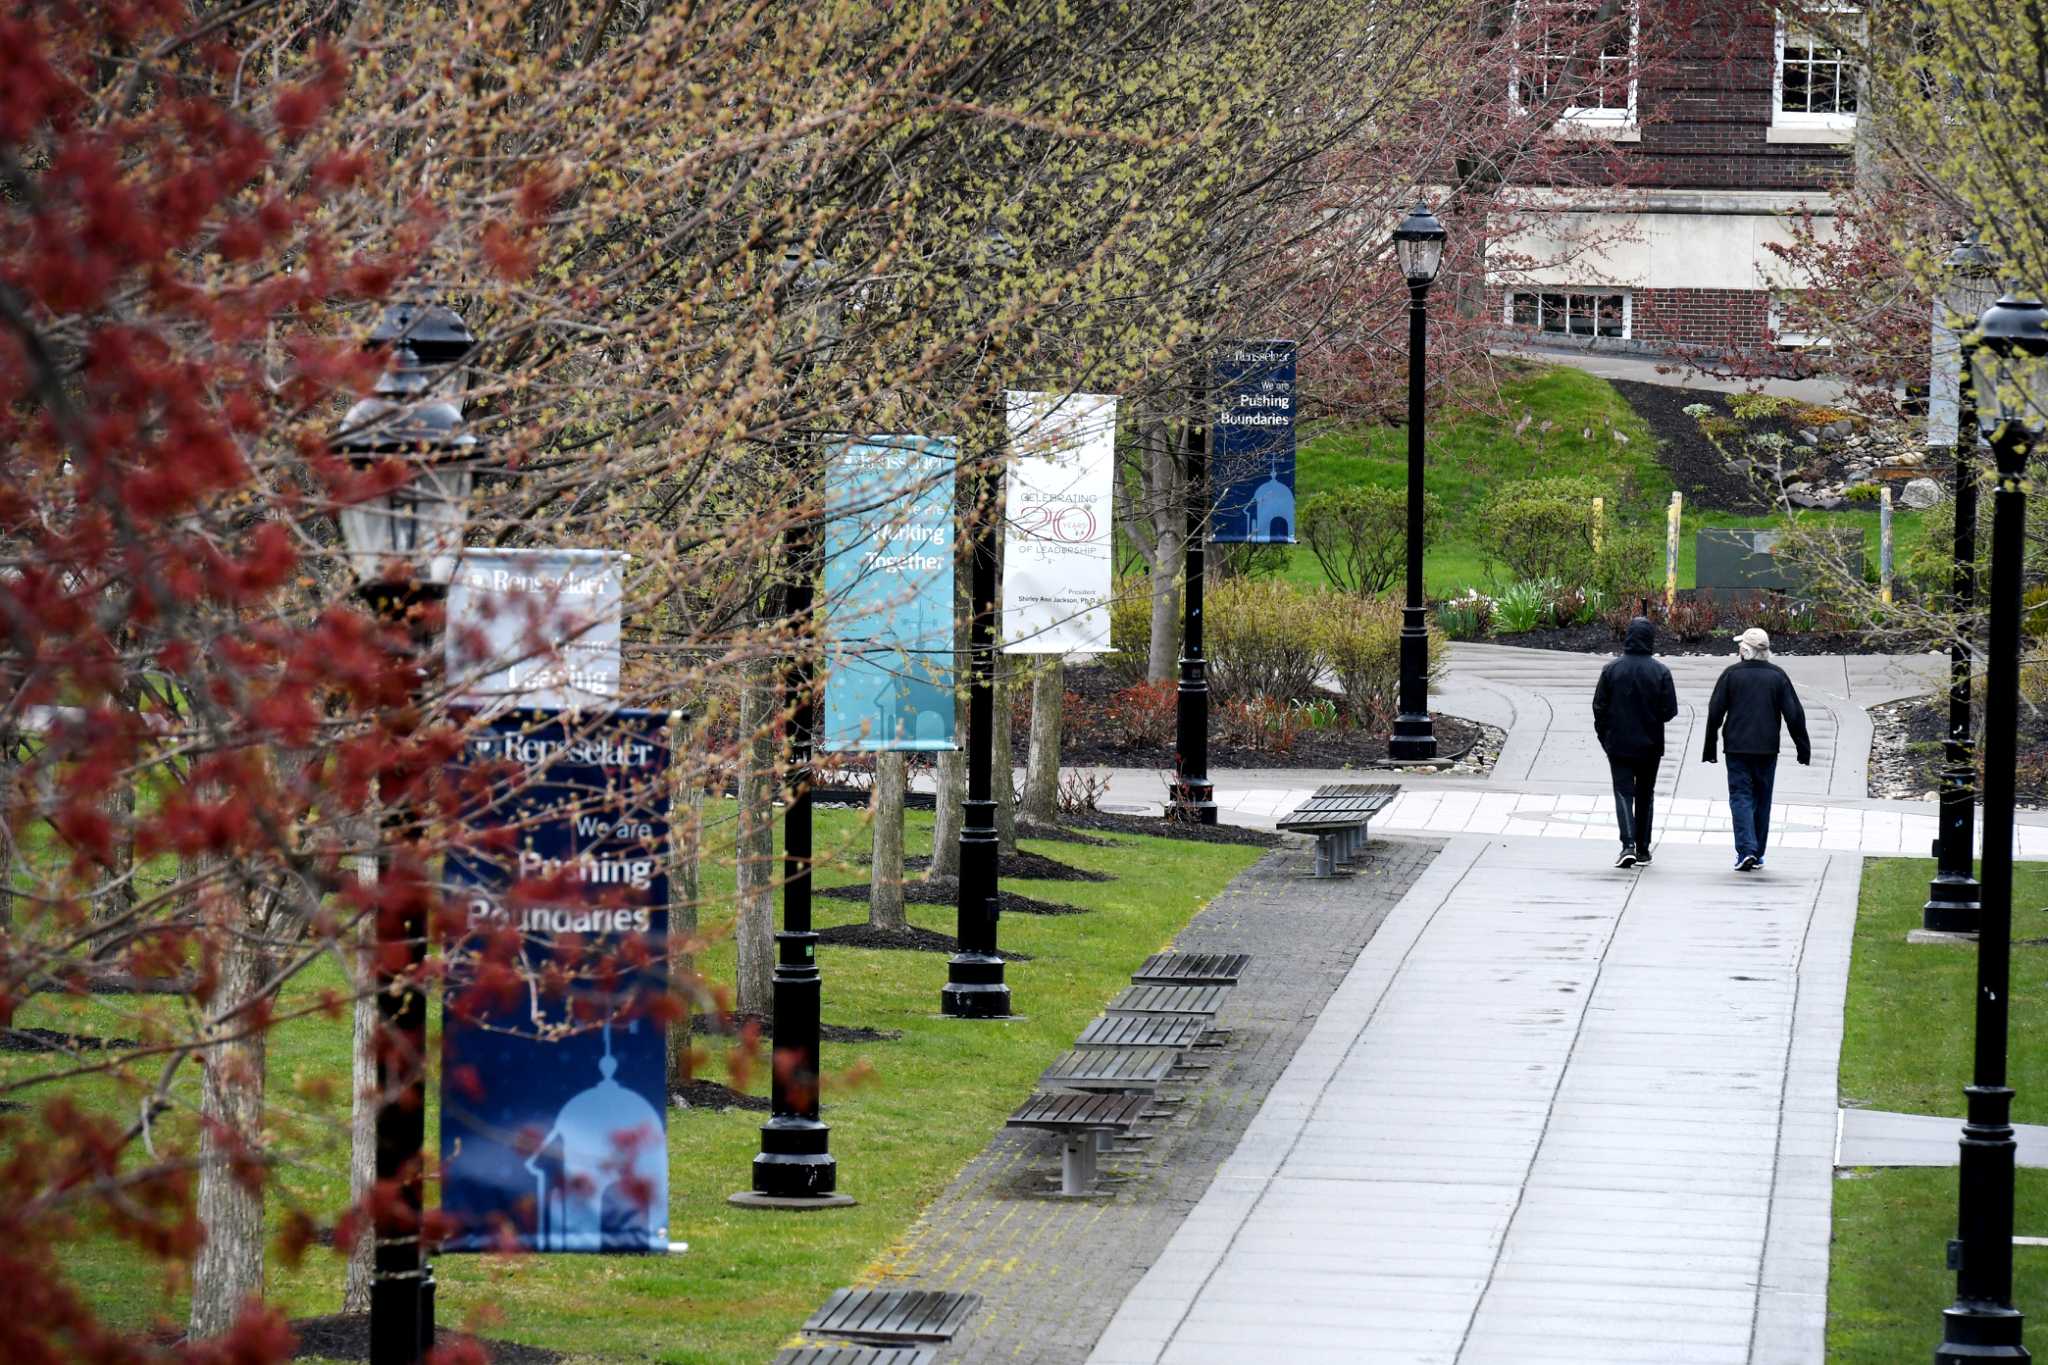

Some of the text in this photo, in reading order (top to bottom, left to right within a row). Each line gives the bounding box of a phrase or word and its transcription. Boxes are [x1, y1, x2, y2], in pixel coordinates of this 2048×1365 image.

[1240, 394, 1290, 409] Pushing
[1221, 412, 1289, 425] Boundaries
[1020, 493, 1098, 503] CELEBRATING
[871, 523, 945, 545] Working
[1020, 506, 1096, 543] 20
[1018, 545, 1097, 554] OF LEADERSHIP
[865, 552, 945, 574] Together
[508, 665, 608, 693] Leaing
[616, 820, 652, 840] are
[519, 853, 653, 888] Puhing
